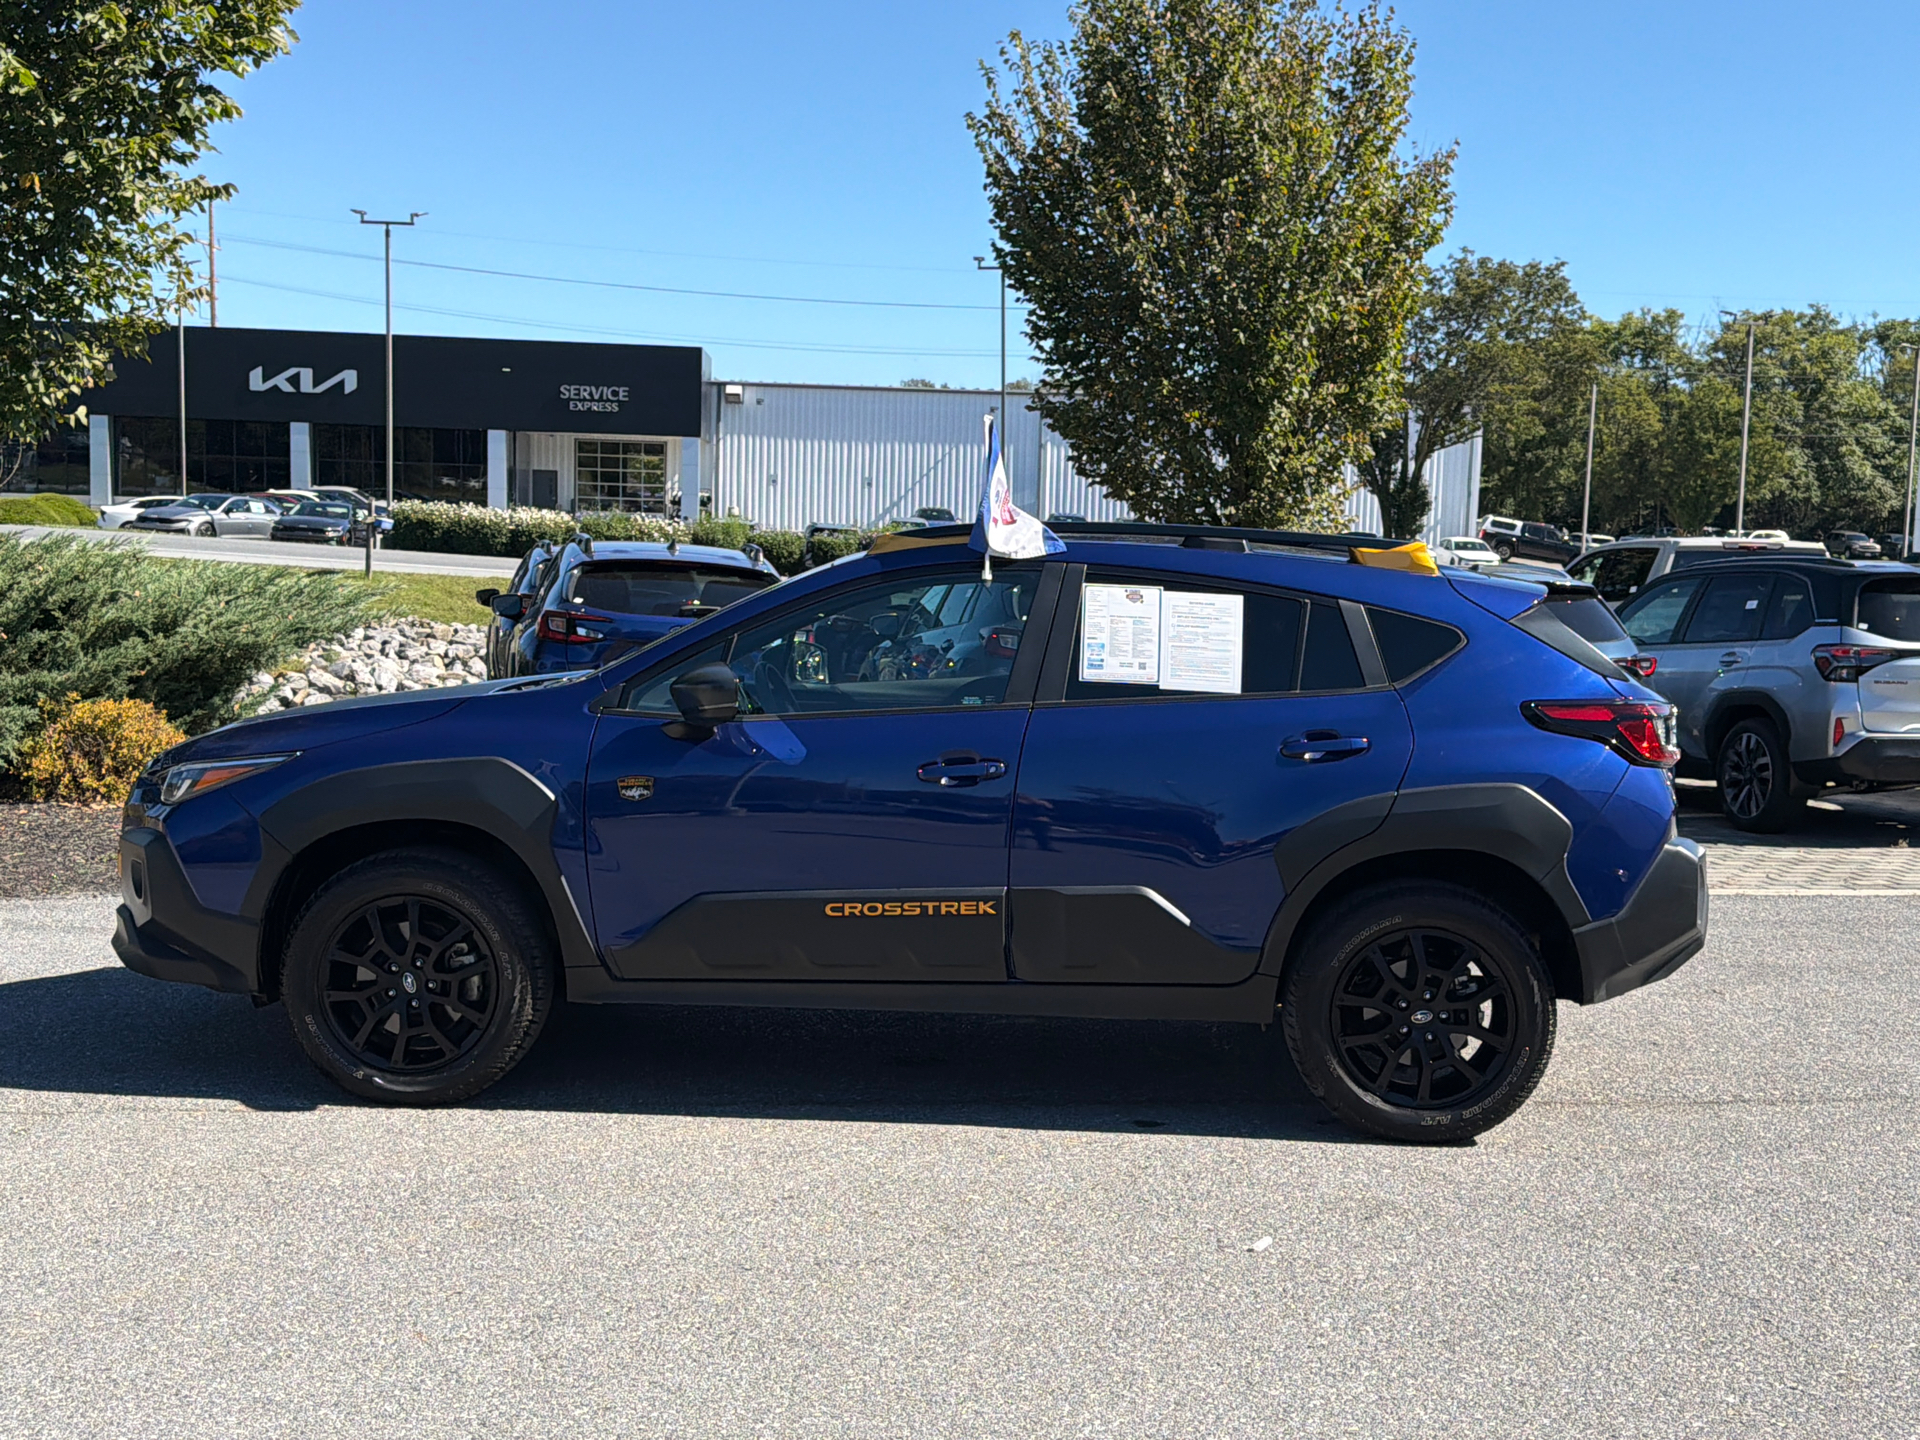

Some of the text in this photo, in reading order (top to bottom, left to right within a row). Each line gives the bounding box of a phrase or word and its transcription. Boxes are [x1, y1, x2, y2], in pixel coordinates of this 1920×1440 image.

[249, 365, 358, 395] KIA
[559, 384, 630, 401] SERVICE
[569, 401, 620, 413] EXPRESS
[423, 882, 501, 942] GEOLANDAR
[824, 901, 997, 917] CROSSTREK
[1330, 914, 1403, 968] YOKOHAMA
[1420, 1046, 1530, 1126] GEOLANDAR A/T
